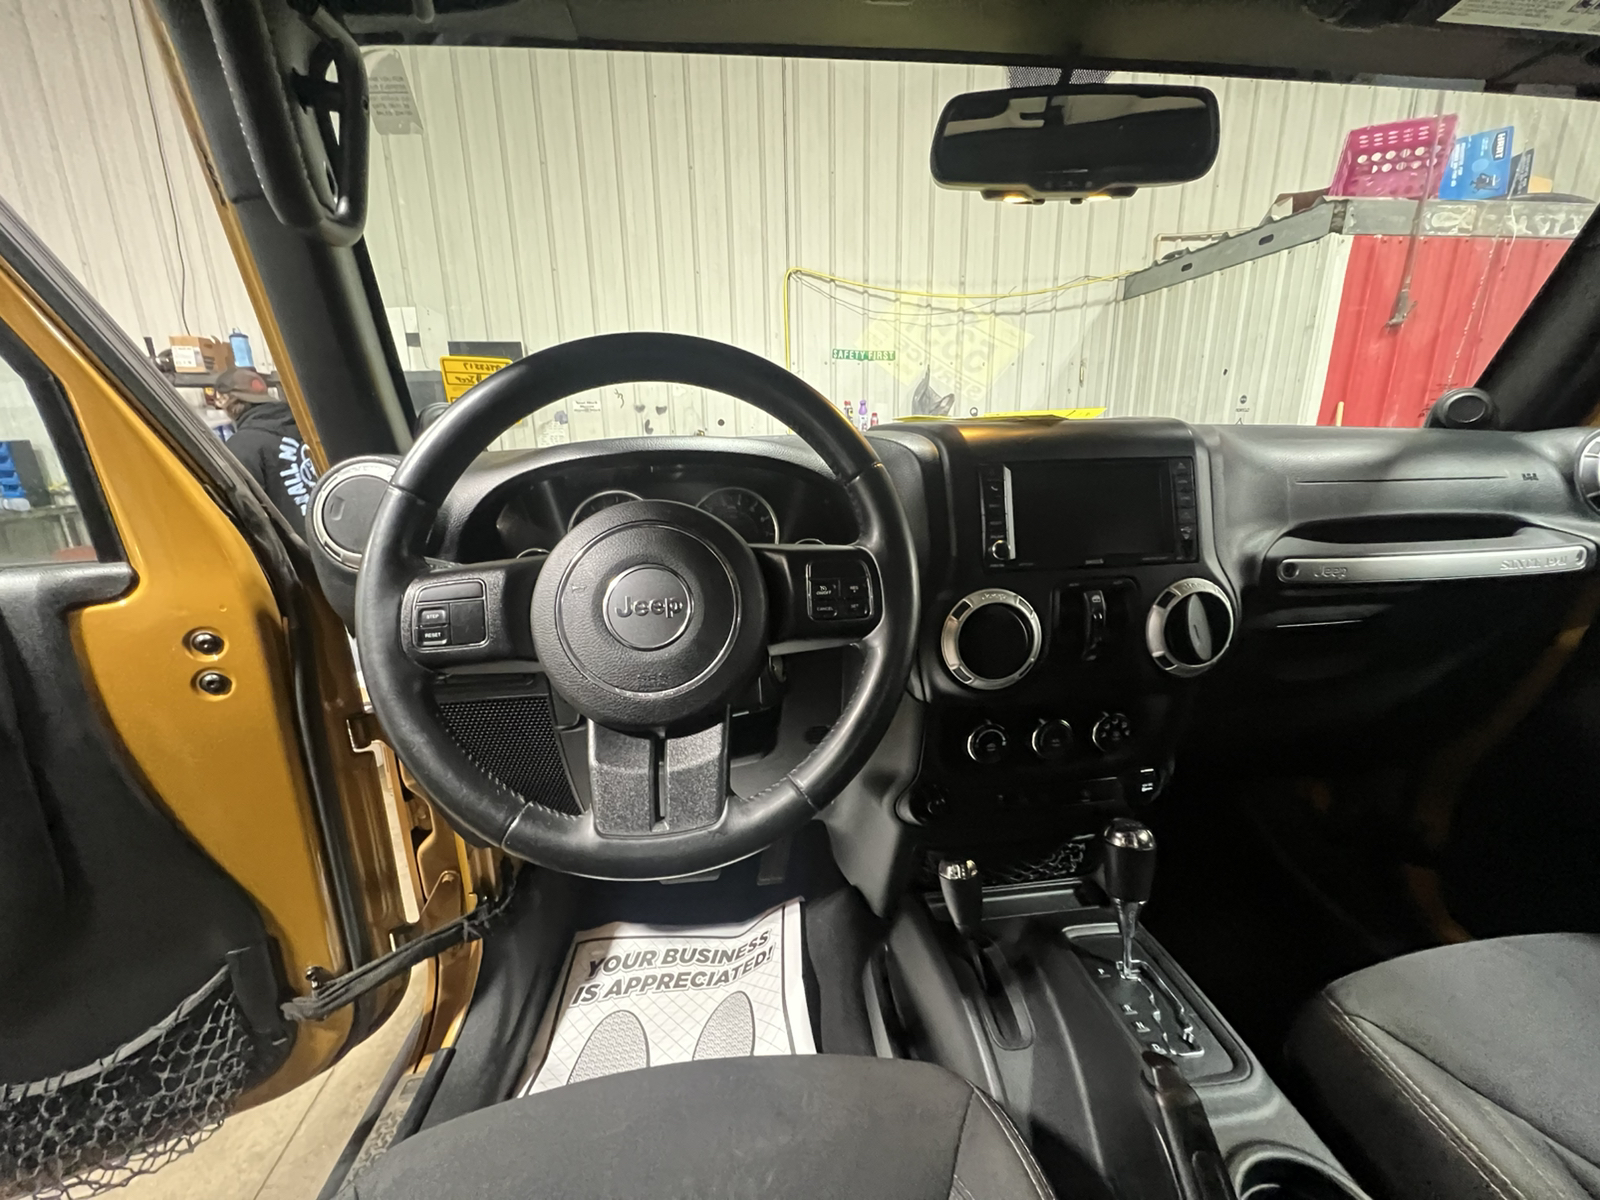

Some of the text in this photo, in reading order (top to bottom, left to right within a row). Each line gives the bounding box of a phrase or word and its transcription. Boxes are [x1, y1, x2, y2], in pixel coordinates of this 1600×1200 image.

[833, 349, 895, 360] SAFETY FIRST
[1313, 565, 1348, 580] Jeep
[1499, 558, 1542, 571] SINCE
[614, 595, 683, 619] Jeep
[588, 929, 770, 978] YOUR BUSINESS
[572, 945, 774, 1005] IS APPRECIATED!
